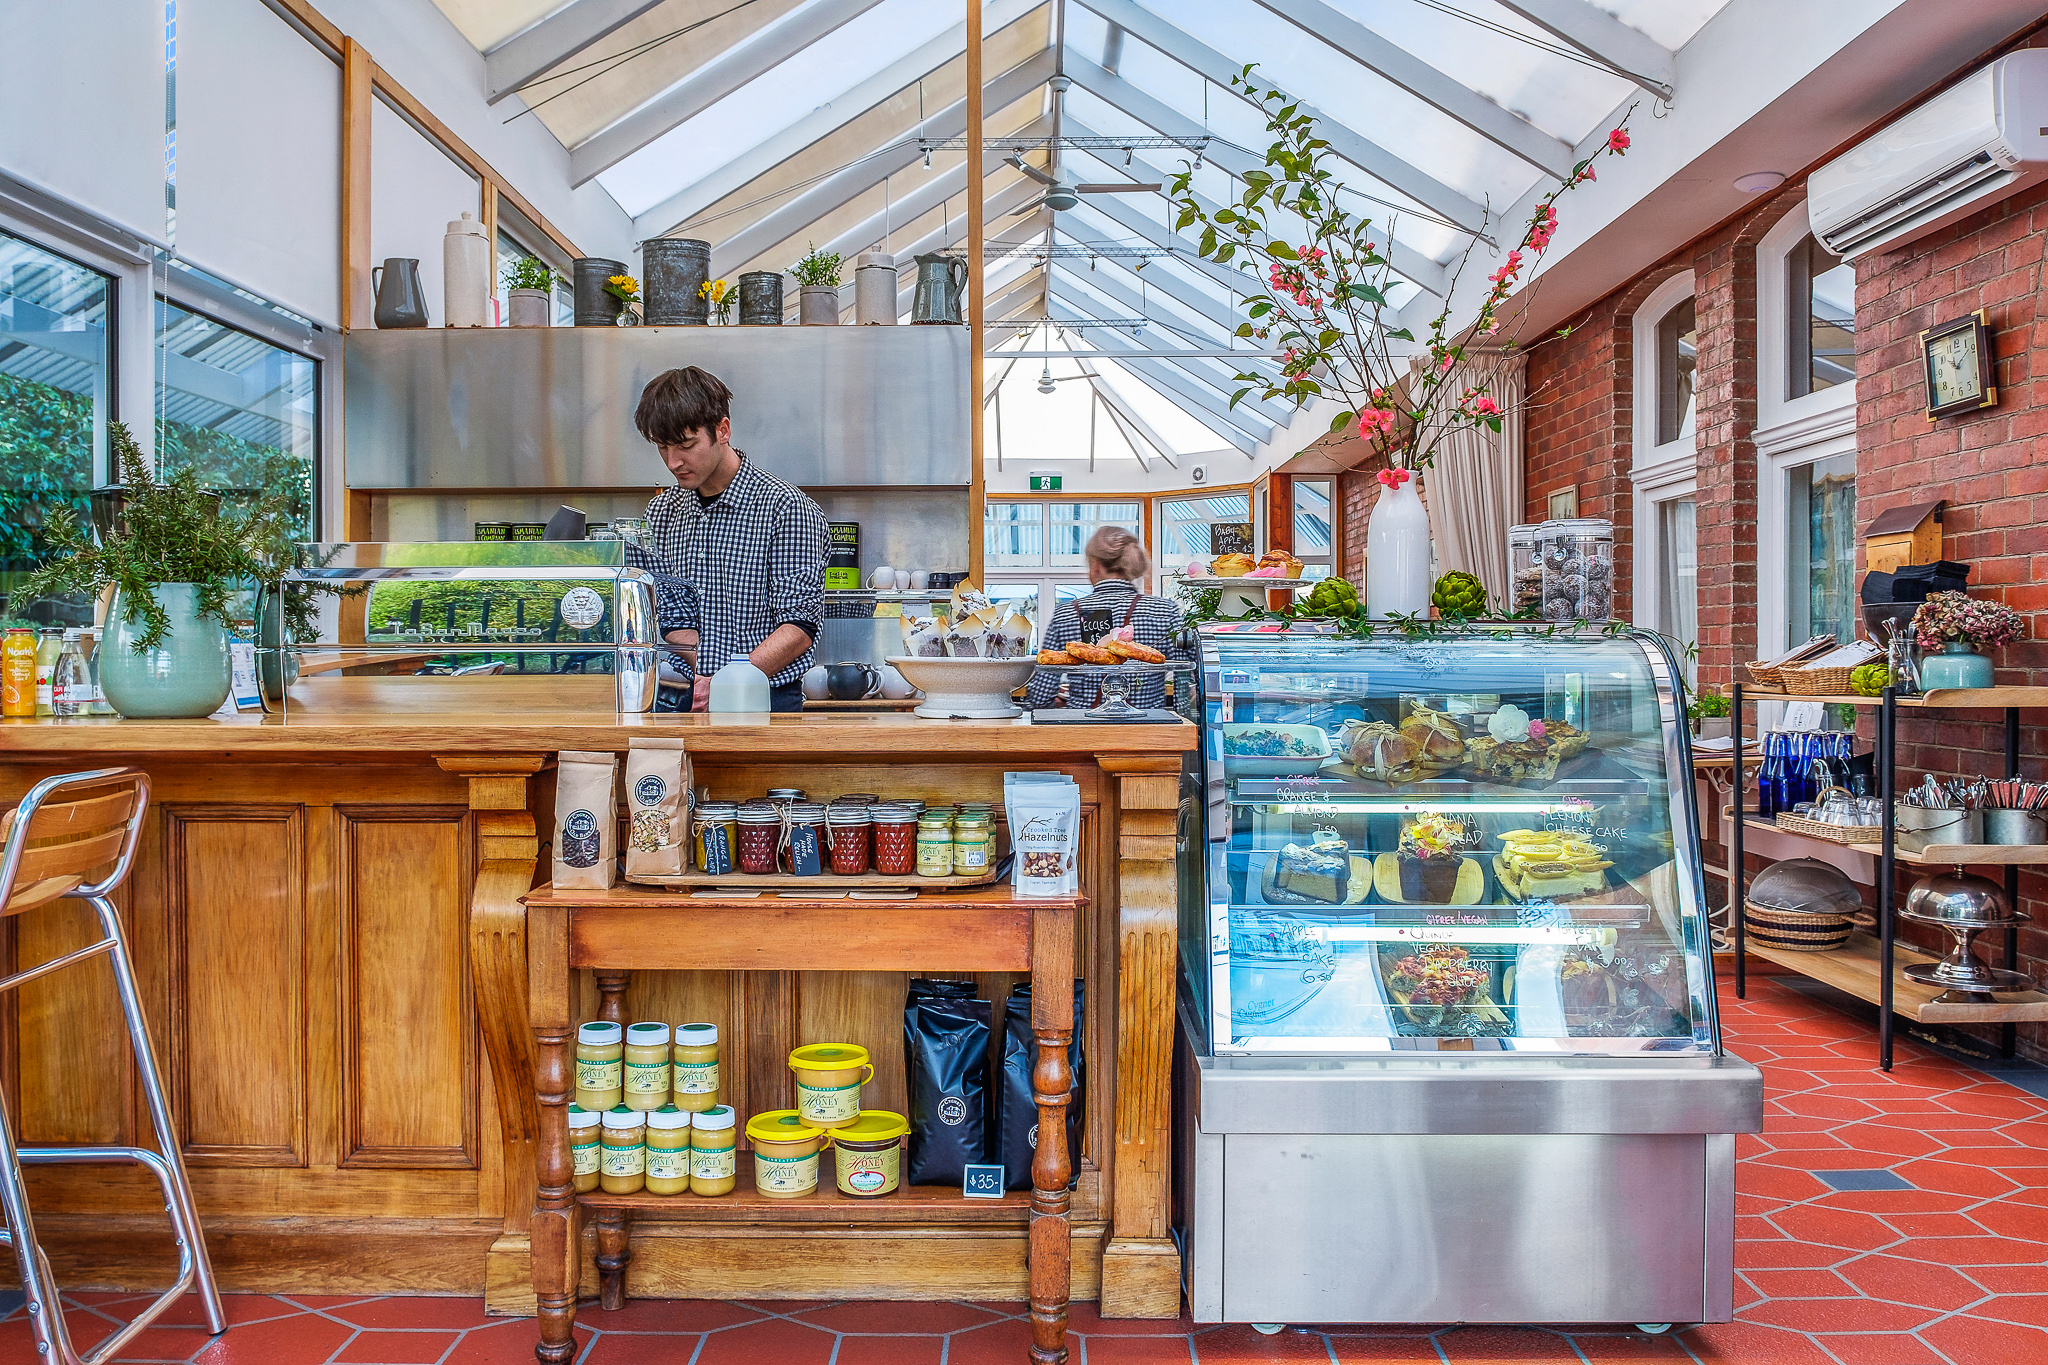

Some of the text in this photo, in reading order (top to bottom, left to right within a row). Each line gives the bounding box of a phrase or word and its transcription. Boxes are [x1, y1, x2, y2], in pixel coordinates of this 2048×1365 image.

[1218, 536, 1241, 545] APPLE
[1219, 545, 1238, 553] PIES
[1083, 620, 1110, 631] ECCLES
[7, 646, 34, 656] Noah's
[1277, 787, 1318, 803] ORANGE
[1294, 805, 1339, 819] ALMOND
[1549, 809, 1592, 824] LEMON
[1024, 833, 1068, 842] Hazelnuts
[1545, 823, 1628, 842] CHEESE CAKE
[1408, 942, 1451, 954] VEGAN
[1302, 952, 1335, 969] CAKE
[1417, 954, 1493, 977] RASPBERRY
[802, 1092, 839, 1109] HONEY
[845, 1154, 885, 1171] HONEY
[761, 1164, 799, 1180] HONEY
